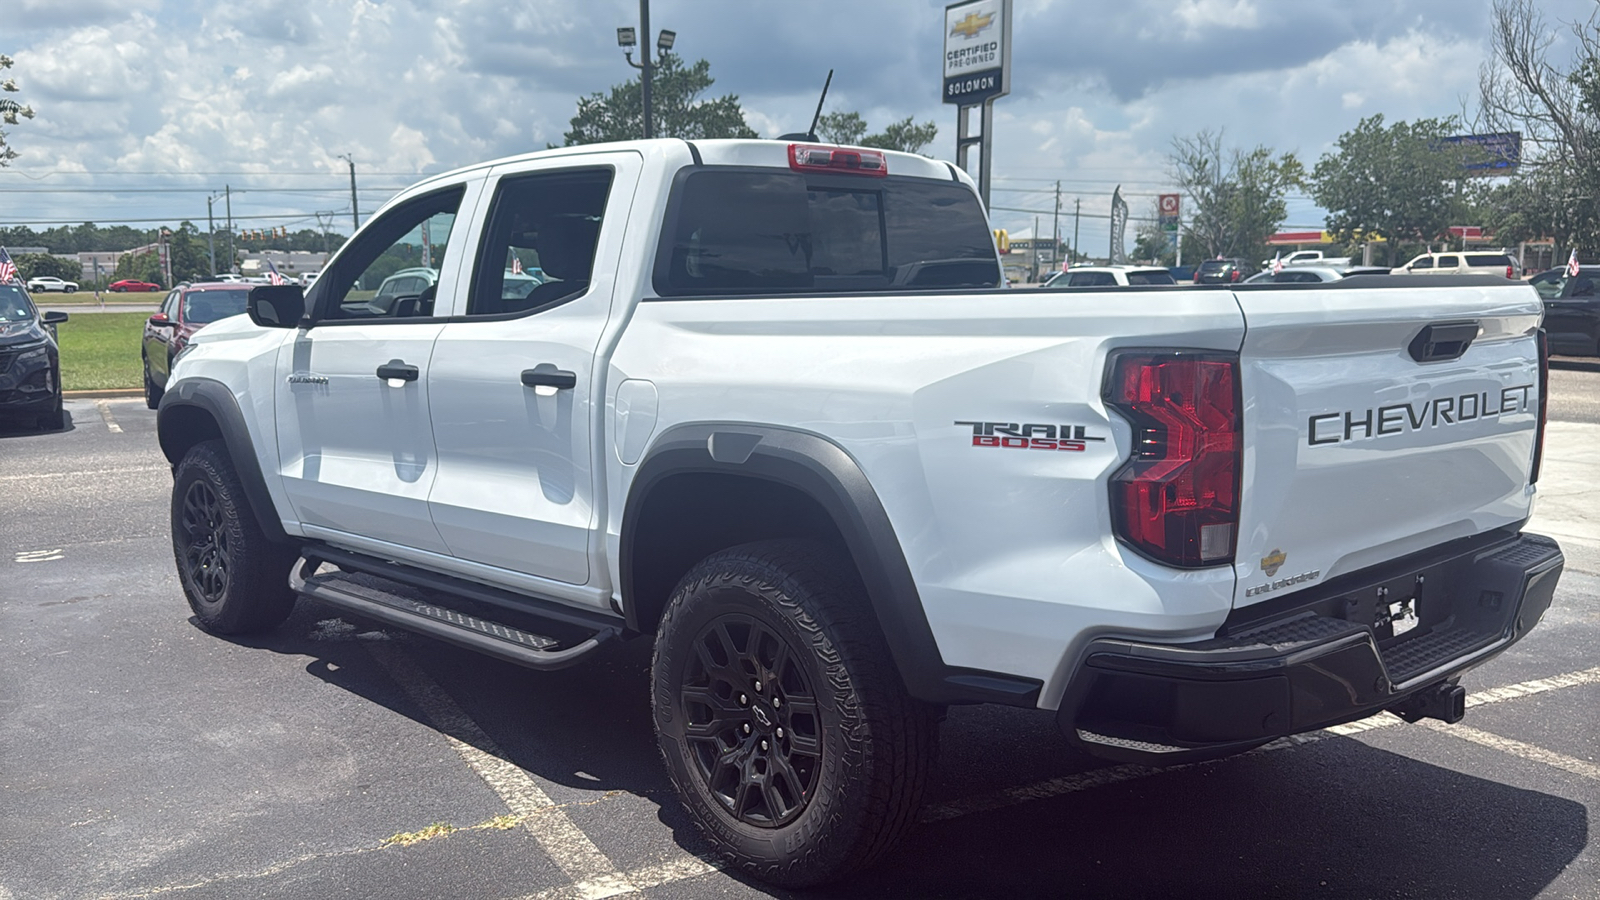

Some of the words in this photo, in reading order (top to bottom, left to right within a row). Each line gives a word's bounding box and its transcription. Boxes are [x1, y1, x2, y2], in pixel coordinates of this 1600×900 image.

[946, 41, 998, 61] CERTIFIED
[948, 52, 995, 69] PRE-OWNED
[948, 76, 995, 96] SOLOMON
[1308, 384, 1534, 446] CHEVROLET
[954, 420, 1106, 443] TRAIL
[972, 435, 1086, 452] BOSS
